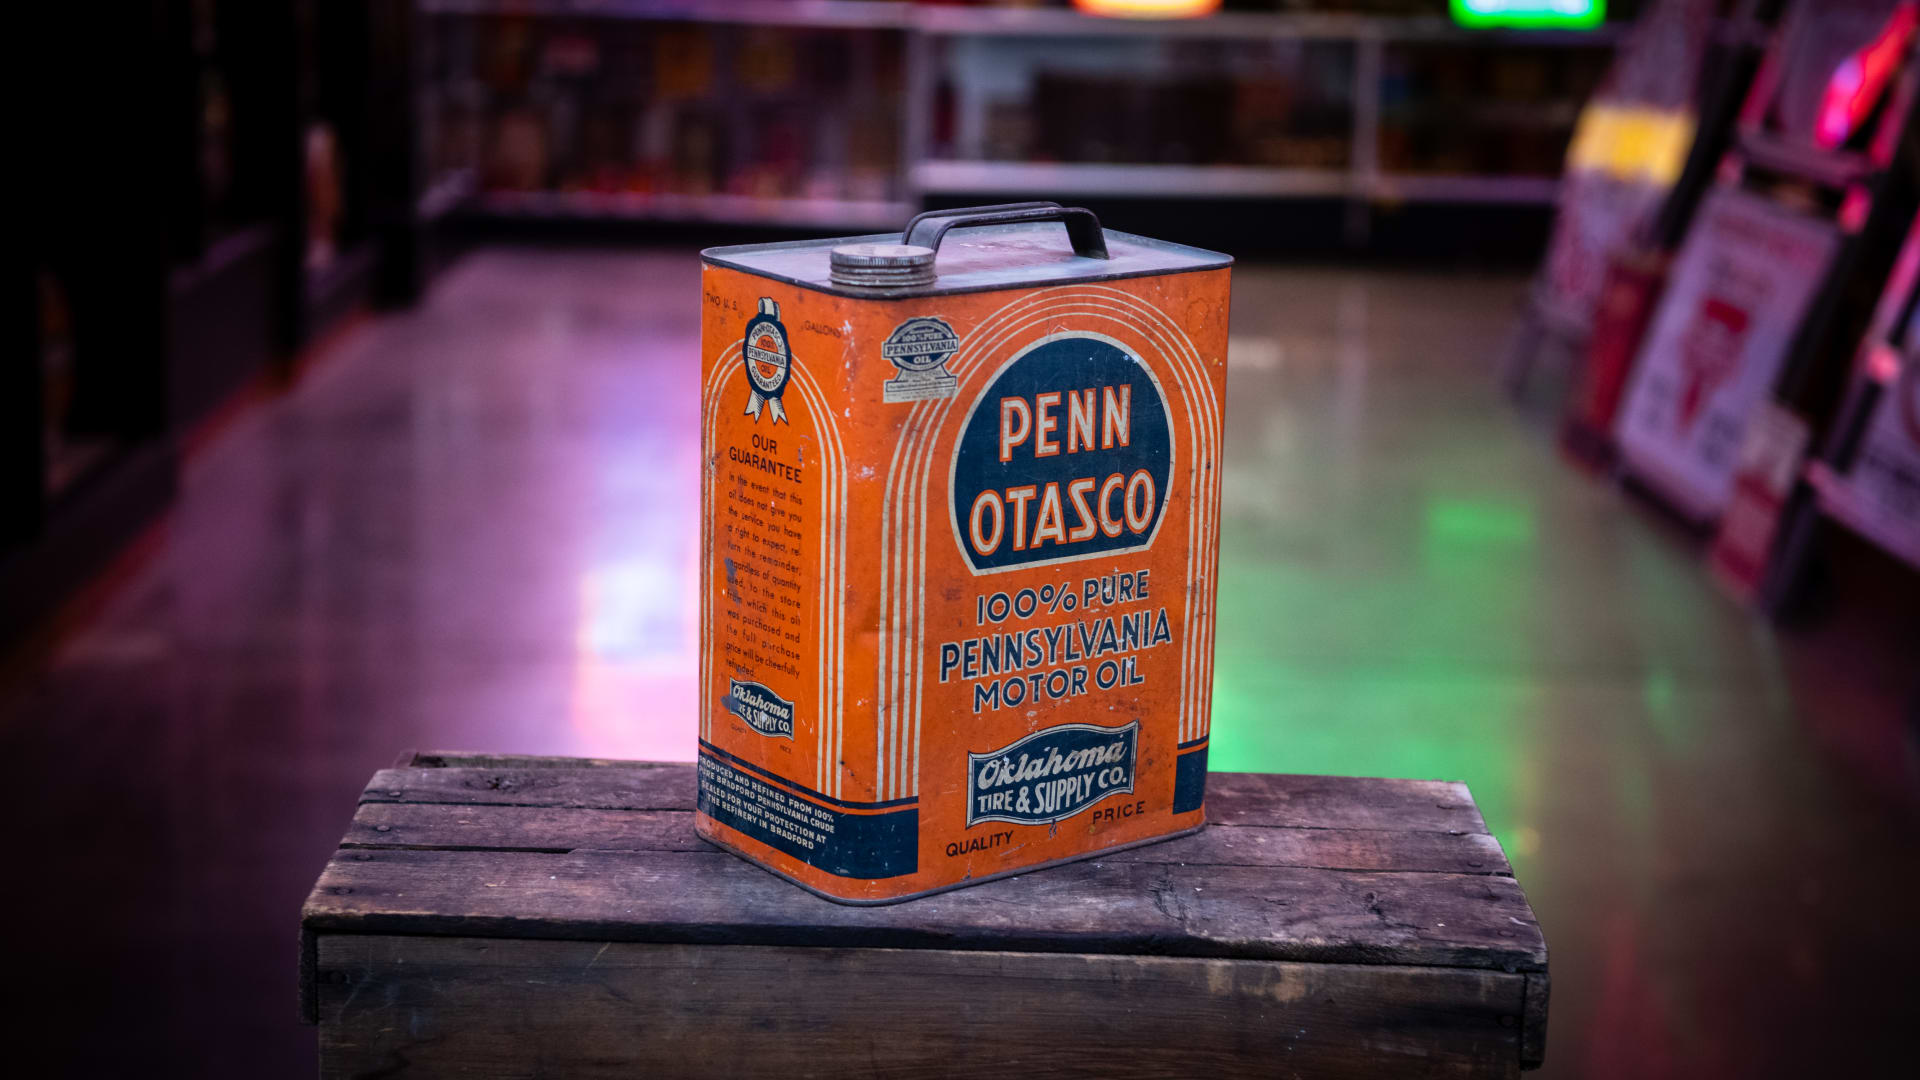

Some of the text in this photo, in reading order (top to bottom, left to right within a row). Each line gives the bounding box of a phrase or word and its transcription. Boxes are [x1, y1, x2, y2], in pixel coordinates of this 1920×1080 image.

[748, 347, 785, 366] PENNSYLVANIA
[887, 340, 956, 355] PENNSYLVANIA
[913, 355, 931, 364] OIL
[752, 433, 777, 455] OUR
[998, 384, 1132, 462] PENN
[729, 446, 802, 484] GUARANTEE
[969, 468, 1156, 557] OTASCO
[780, 595, 800, 608] store
[977, 569, 1150, 626] 100% PURE
[743, 616, 780, 636] purchased
[785, 632, 800, 643] and
[939, 607, 1172, 684] PENNSYLVANIA
[733, 685, 789, 719] Oklahoma
[973, 655, 1144, 715] MOTOR OIL
[779, 719, 791, 733] CO.
[978, 739, 1127, 790] Oklahoma
[701, 780, 826, 844] SEALED FOR YOUR PROTECTION AT
[717, 776, 755, 799] BRADFORD
[758, 795, 808, 824] PENNSYLVANIA
[810, 818, 835, 833] CRUDE
[735, 775, 750, 786] AND
[752, 782, 785, 803] REFINED
[789, 799, 811, 815] FROM
[815, 808, 834, 823] 100%
[978, 766, 1127, 814] TIRE & SUPPLY CO.
[707, 792, 814, 850] THE REFINERY IN BRADFORD
[945, 801, 1145, 857] QUALITY PRICE
